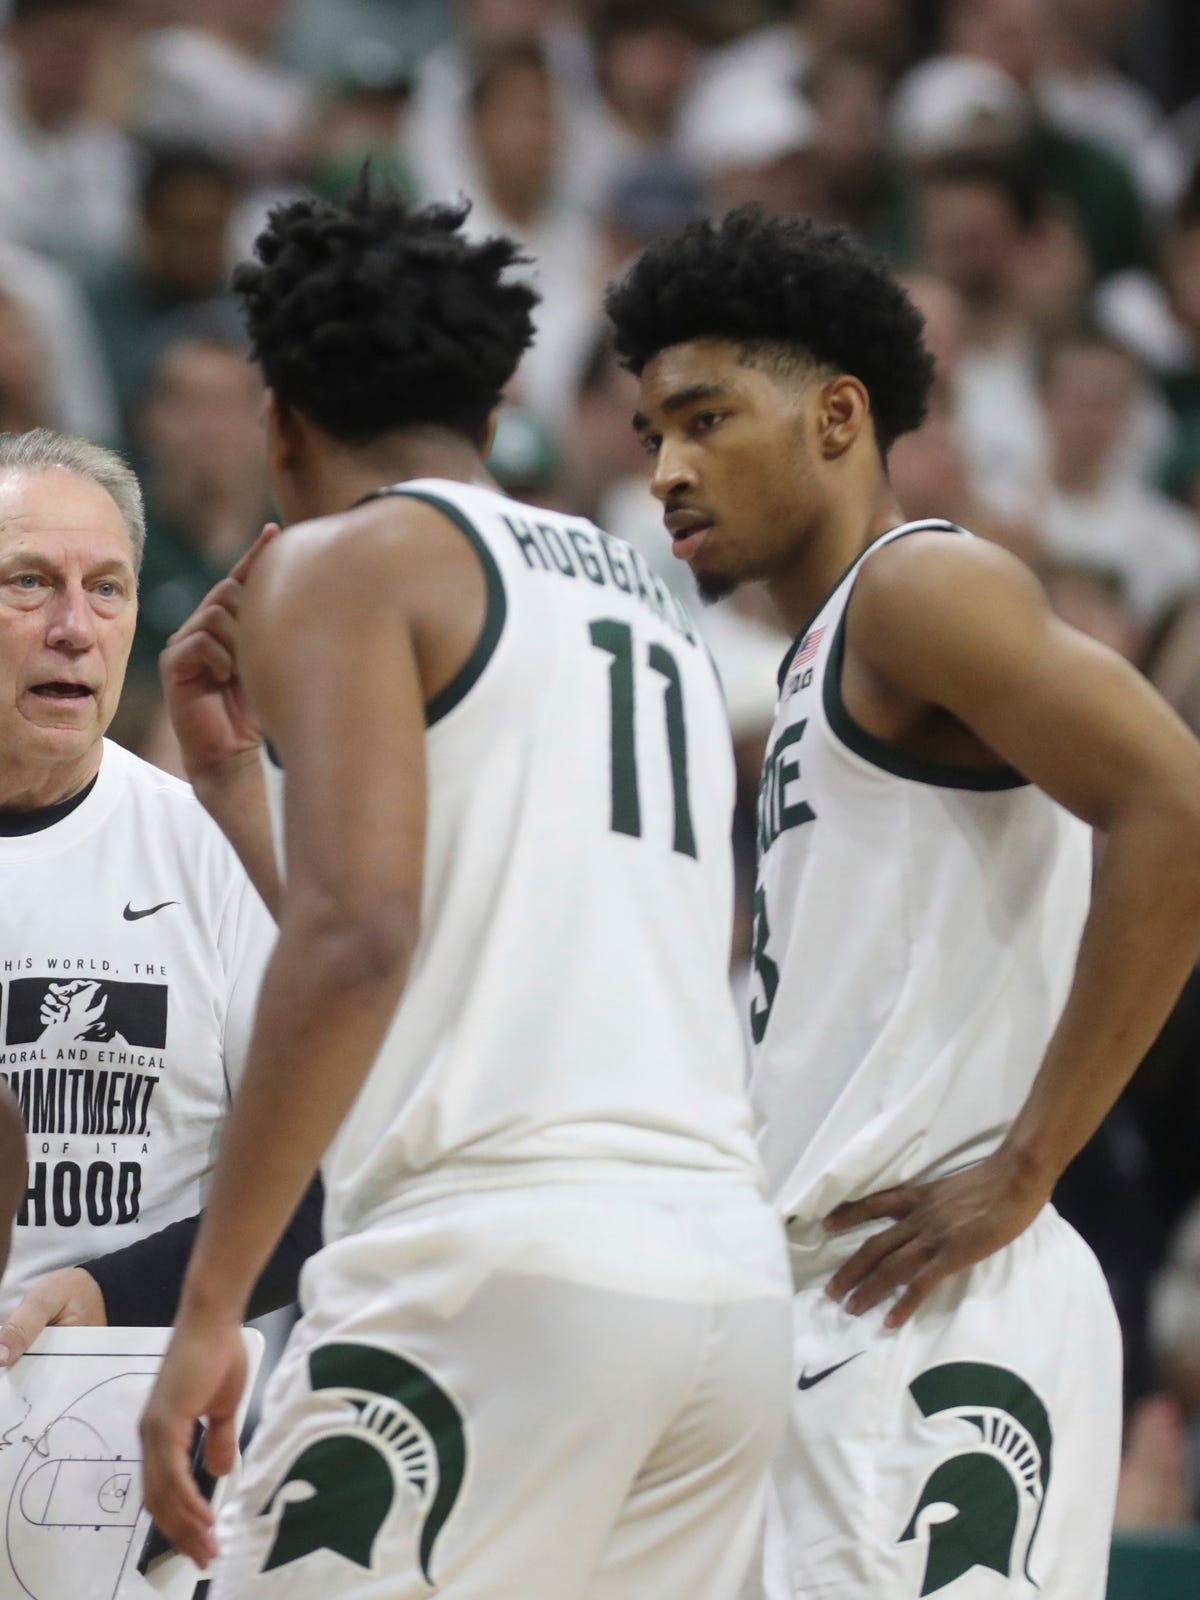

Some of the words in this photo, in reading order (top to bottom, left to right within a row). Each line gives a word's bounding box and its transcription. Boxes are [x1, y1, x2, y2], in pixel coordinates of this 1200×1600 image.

[588, 618, 699, 861] 11
[48, 958, 119, 975] WORLD,
[134, 963, 167, 976] THE
[56, 1048, 88, 1061] AND
[97, 1051, 166, 1069] ETHICAL
[41, 1142, 70, 1154] OF
[96, 1142, 117, 1154] IT
[141, 1142, 148, 1154] A
